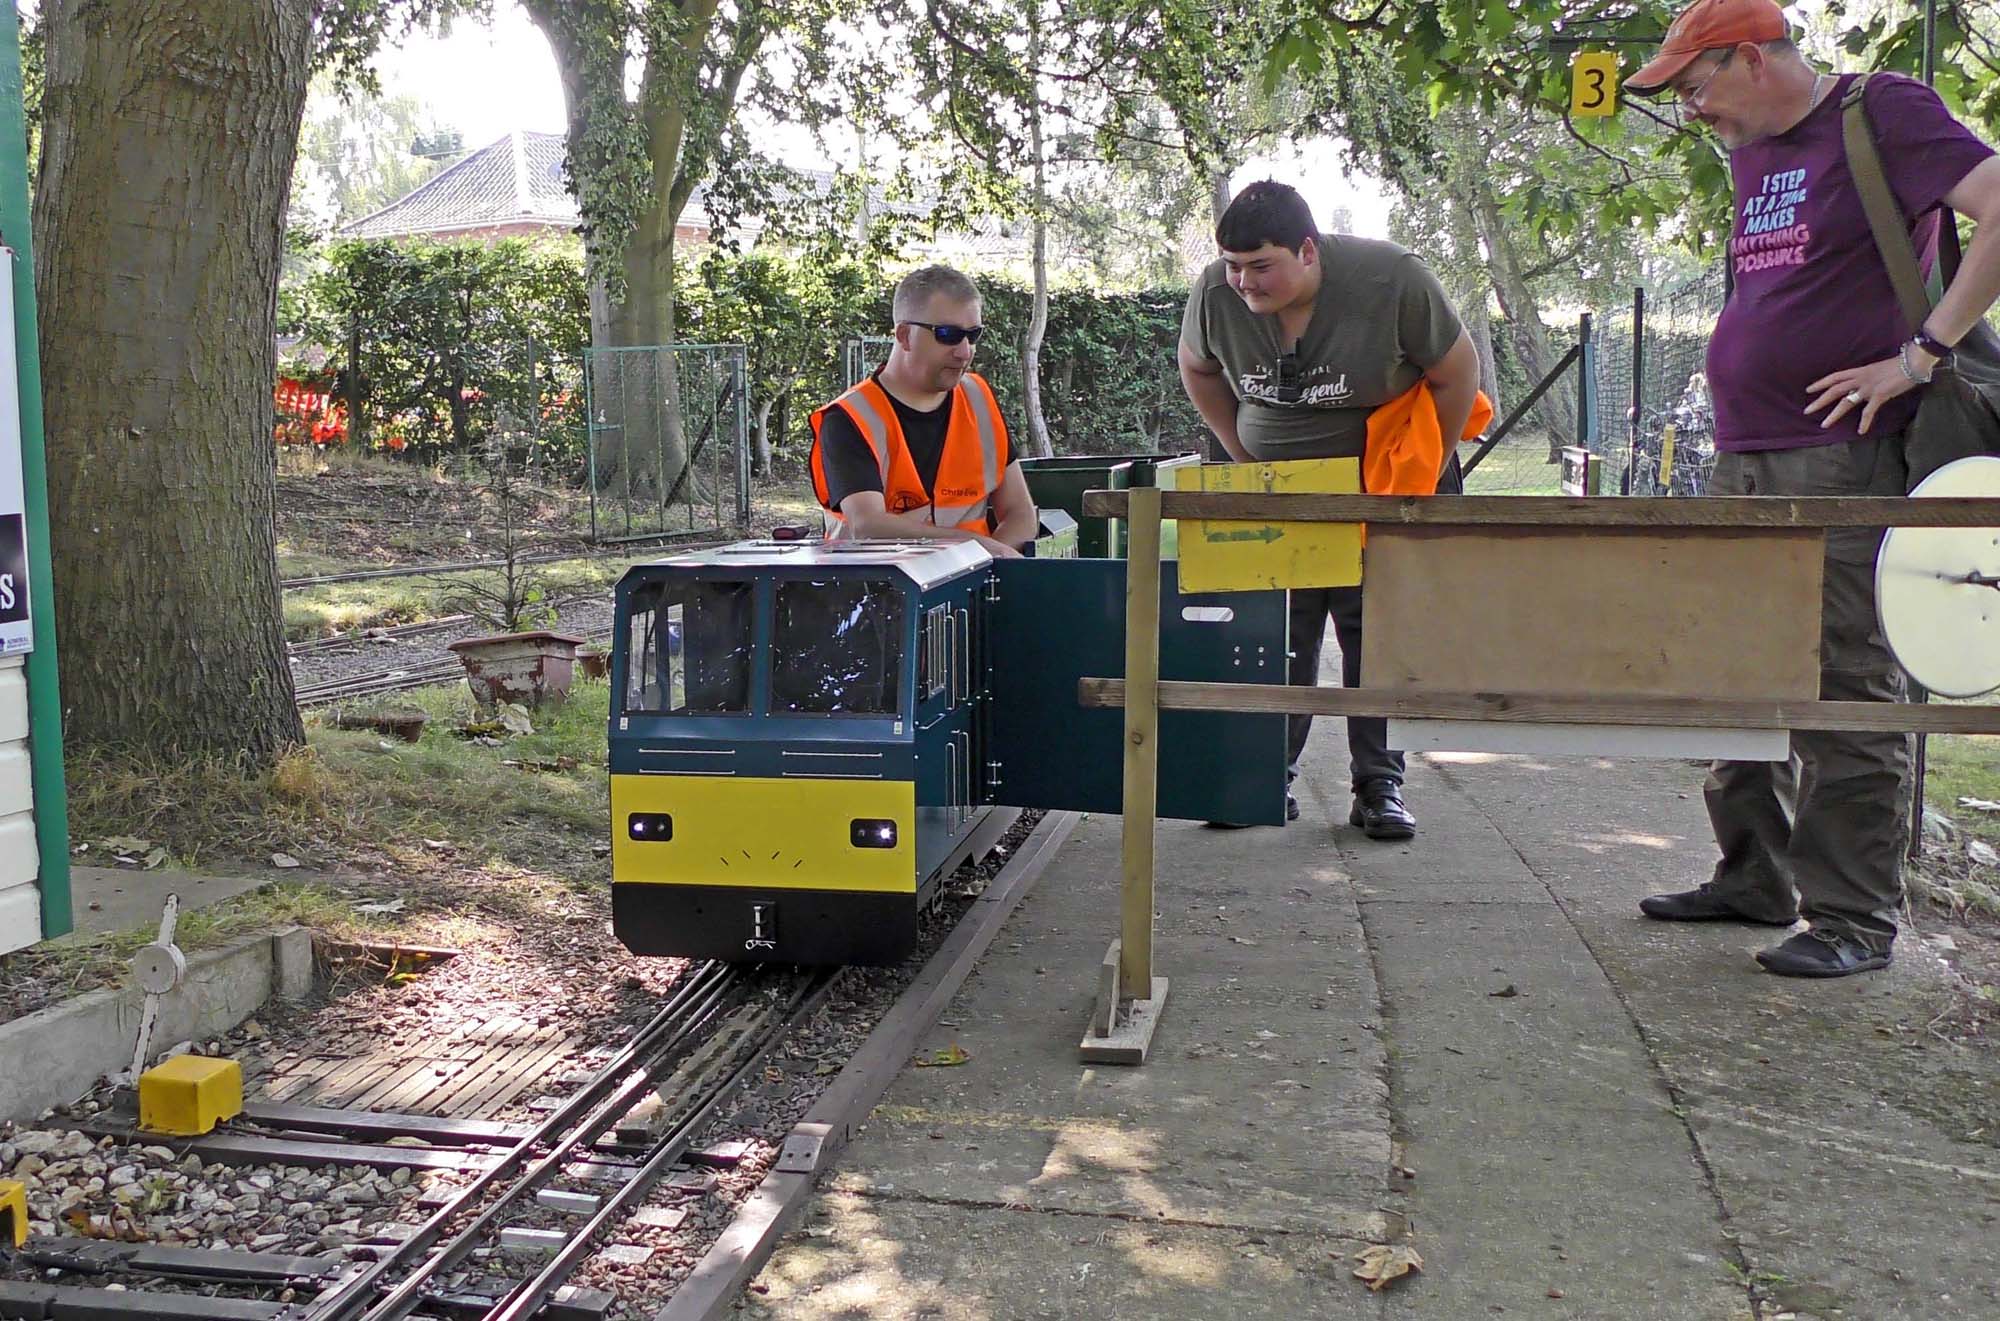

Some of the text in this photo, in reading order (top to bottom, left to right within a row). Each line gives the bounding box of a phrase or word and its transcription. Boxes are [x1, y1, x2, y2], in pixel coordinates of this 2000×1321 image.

[1581, 68, 1605, 109] 3
[1770, 168, 1807, 193] STEP
[1743, 189, 1807, 217] AT A TIME
[1744, 206, 1796, 235] MAKES
[1731, 223, 1810, 256] ANYTHING
[1299, 374, 1347, 404] egend
